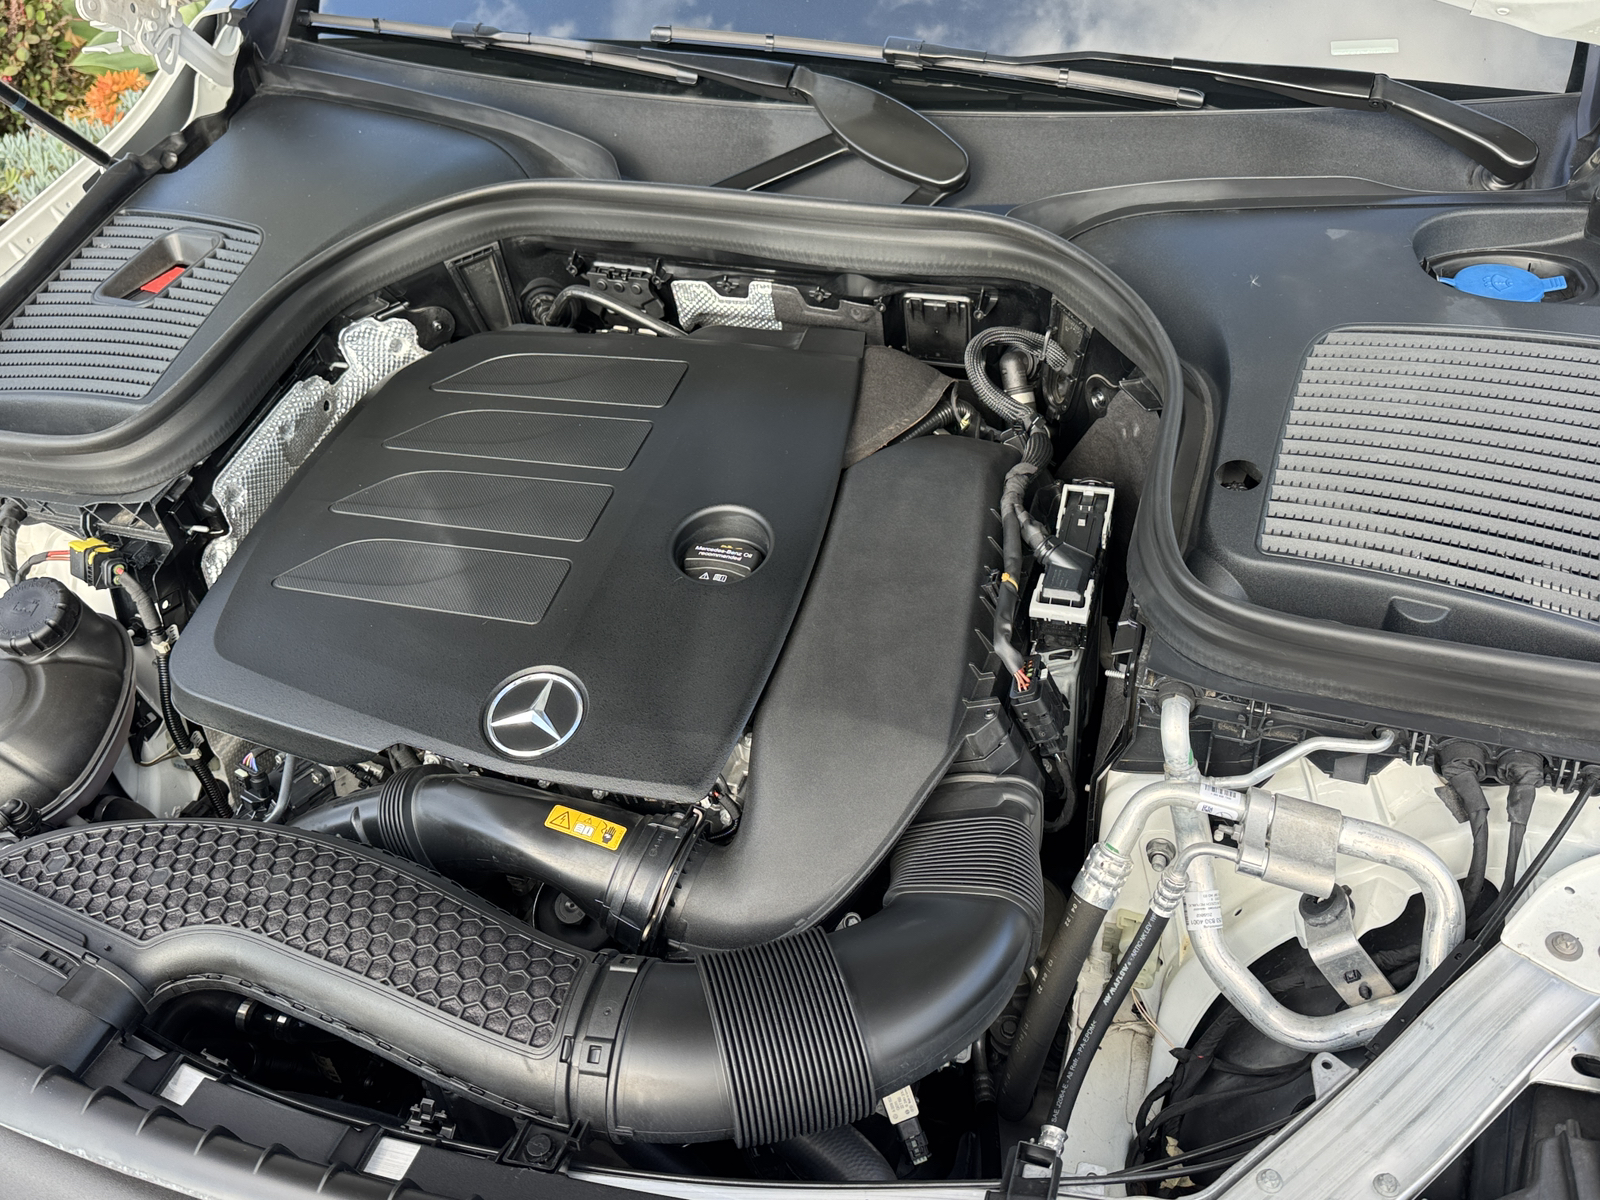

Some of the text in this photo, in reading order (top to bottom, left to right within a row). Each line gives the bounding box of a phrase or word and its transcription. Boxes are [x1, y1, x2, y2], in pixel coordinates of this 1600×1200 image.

[695, 545, 742, 556] Mercedes-Benz
[698, 551, 742, 561] recommended
[1051, 1108, 1060, 1123] SAE
